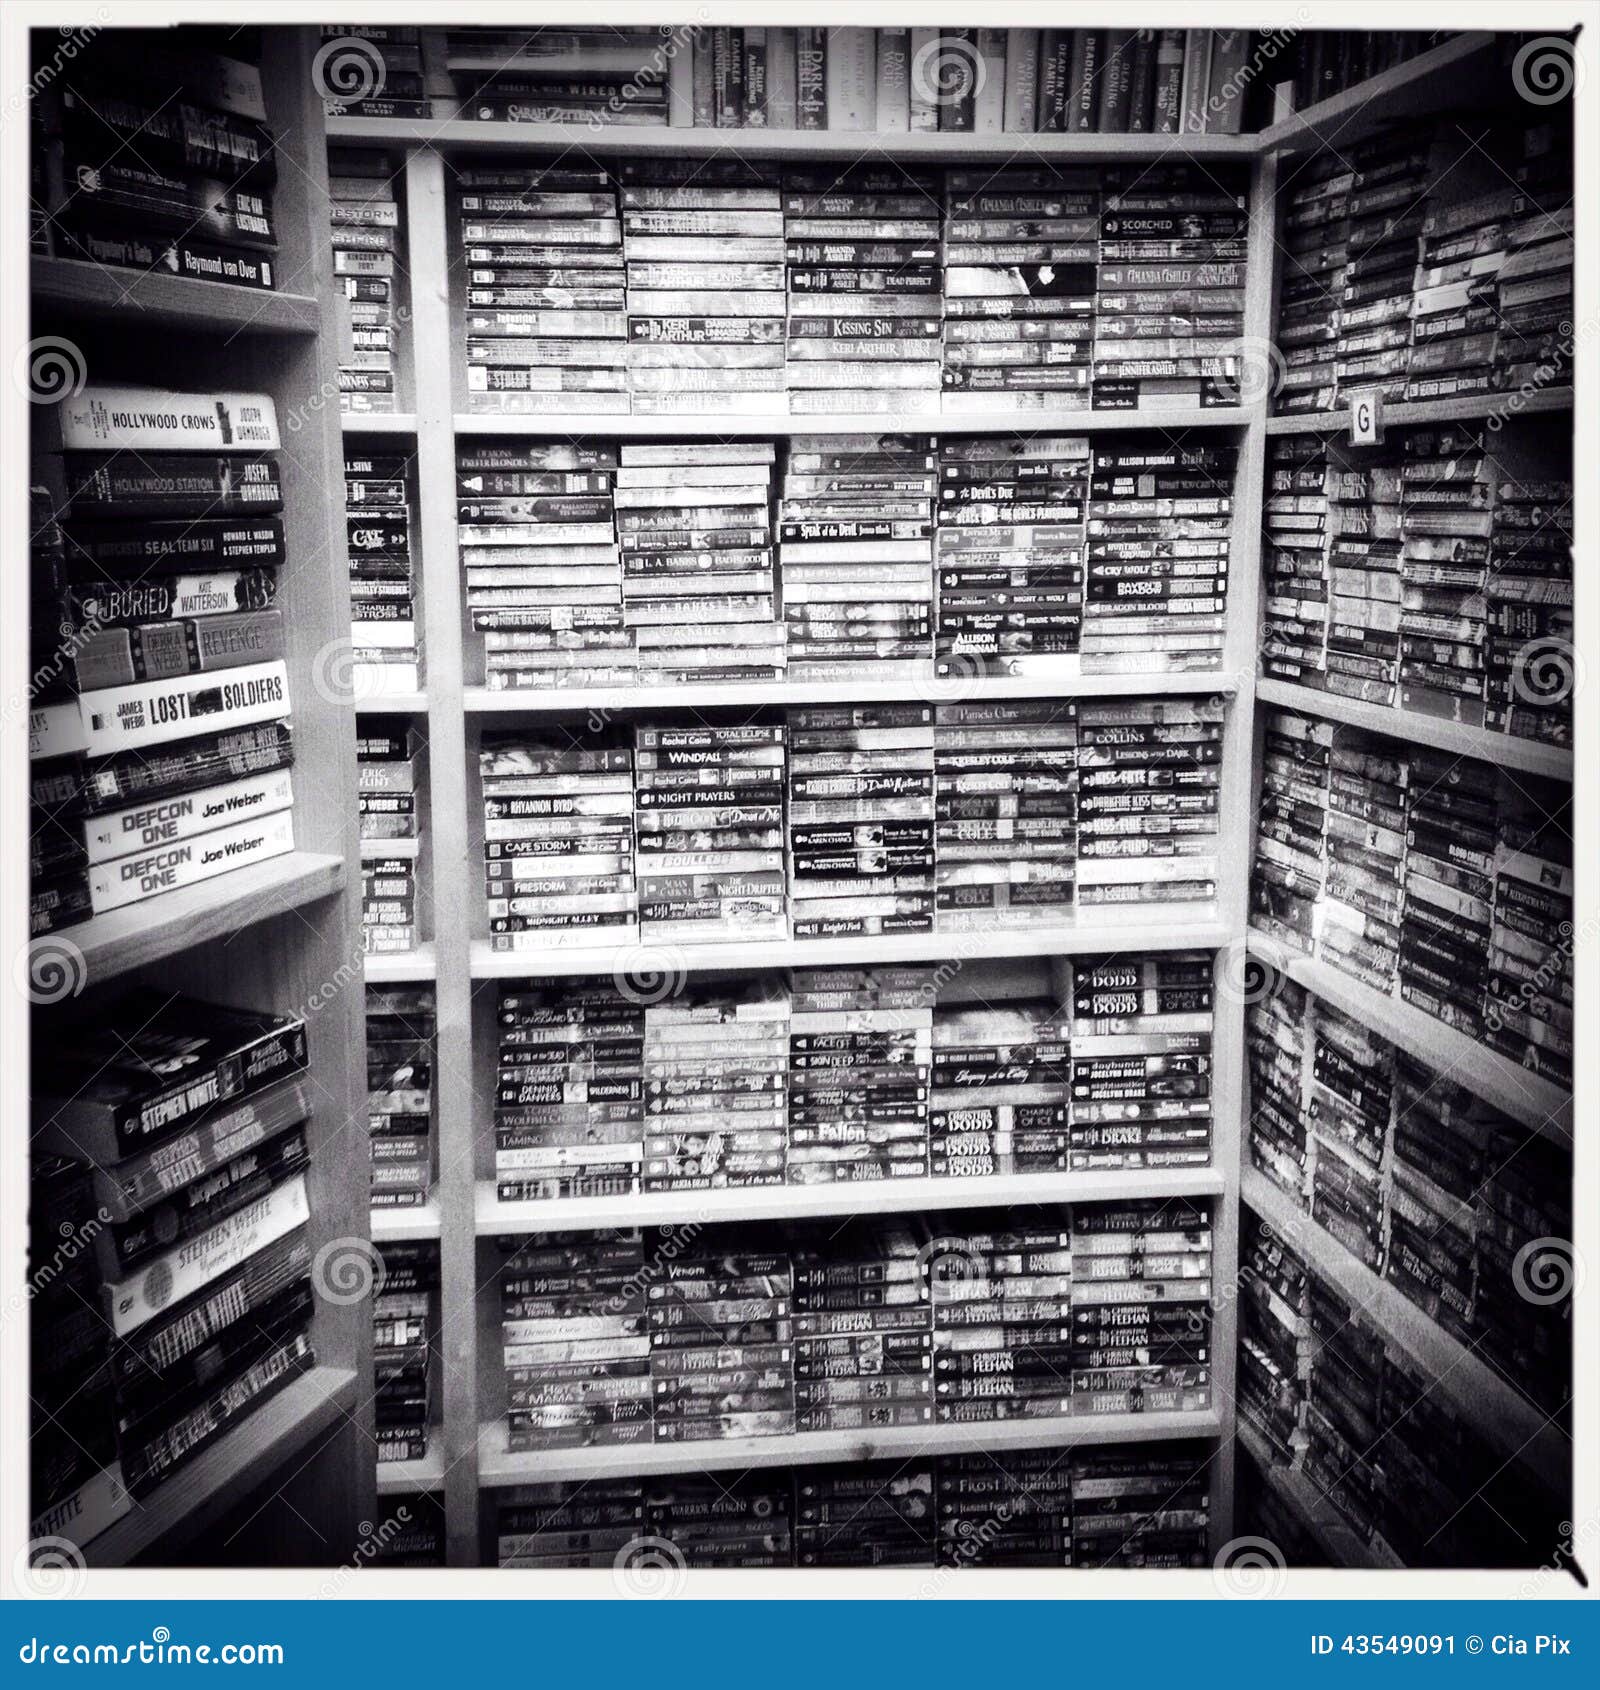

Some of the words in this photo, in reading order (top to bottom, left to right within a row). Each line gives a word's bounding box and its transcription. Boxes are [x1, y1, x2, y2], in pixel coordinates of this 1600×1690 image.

[1045, 57, 1056, 96] FAMILY
[1081, 38, 1096, 110] DEADLOCKED
[569, 86, 616, 96] WIRED
[1122, 219, 1173, 230] SCORCHED
[826, 253, 854, 262] ASHLEY
[185, 250, 222, 274] Raymond
[224, 261, 238, 276] van
[238, 259, 256, 279] Over
[832, 279, 857, 289] ASHLEY
[886, 276, 905, 286] DEAD
[661, 320, 690, 331] KERI
[833, 320, 870, 337] KISSING
[874, 318, 893, 337] SIN
[659, 330, 706, 341] ARTHUR
[832, 343, 855, 355] KERI
[856, 343, 898, 355] ARTHUR
[112, 412, 178, 430] HOLLYWOOD
[182, 415, 215, 430] CROWS
[240, 407, 261, 423] JOSEPH
[1358, 403, 1370, 434] G
[1117, 457, 1144, 466] ALLISON
[1145, 456, 1175, 466] BRENNAN
[244, 464, 269, 481] JOSEPH
[114, 478, 175, 492] HOLLYWOOD
[177, 478, 214, 490] STATION
[997, 486, 1013, 499] DUE
[223, 531, 245, 541] HOWARD
[253, 530, 274, 540] WASDIN
[145, 542, 174, 554] SEAL
[176, 540, 199, 552] TEAM
[201, 538, 215, 551] SIX
[229, 545, 252, 555] STEPHEN
[254, 544, 276, 554] TEMPLIN
[666, 556, 697, 567] BANKS
[1105, 566, 1122, 575] CRY
[1124, 565, 1150, 575] WOLF
[110, 587, 169, 620] BURIED
[181, 592, 229, 612] WATTERSON
[1101, 602, 1137, 613] DRAGON
[1138, 602, 1167, 611] BLOOD
[355, 610, 398, 619] STROSS
[202, 626, 264, 658] REVENGE
[956, 632, 995, 644] ALLISON
[951, 642, 998, 654] BRENNAN
[149, 693, 186, 725] LOST
[223, 676, 282, 711] SOLDIERS
[117, 700, 143, 717] JAMES
[960, 708, 993, 720] Pamela
[994, 706, 1020, 719] Clare
[122, 716, 145, 731] WEBB
[742, 730, 770, 738] ECLIPSE
[1096, 732, 1145, 744] COLLINS
[662, 737, 686, 746] Rachel
[689, 736, 712, 745] Caine
[669, 752, 722, 763] WINDFALL
[1115, 750, 1149, 760] LESSONS
[1166, 748, 1190, 758] DARK
[362, 769, 385, 777] ERIC
[359, 777, 389, 787] FLINT
[658, 792, 692, 802] NIGHT
[695, 791, 735, 801] PRAYERS
[202, 800, 225, 818] Joe
[225, 791, 266, 811] Weber
[368, 800, 399, 811] WEBER
[510, 800, 551, 815] RHYANNON
[553, 799, 572, 813] BYRD
[122, 800, 193, 832] DEFCON
[142, 821, 178, 844] ONE
[200, 846, 223, 865] Joe
[224, 836, 265, 855] Weber
[505, 842, 532, 852] CAPE
[533, 840, 571, 851] STORM
[121, 846, 192, 881] DEFCON
[141, 869, 176, 892] ONE
[514, 882, 566, 893] FIRESTORM
[717, 884, 747, 895] NIGHT
[748, 883, 782, 894] DRIFTER
[527, 916, 568, 926] MIDNIGHT
[571, 915, 600, 924] ALLEY
[1092, 976, 1137, 987] DODD
[1164, 991, 1199, 1000] CHAINS
[1093, 1002, 1137, 1014] DODD
[1182, 1000, 1198, 1009] ICE
[813, 1039, 835, 1048] FACE
[832, 1057, 854, 1067] DEEP
[521, 1085, 558, 1093] DENNIS
[518, 1092, 562, 1103] DANVERS
[141, 1094, 187, 1134] STEPHEN
[187, 1077, 220, 1112] WHITE
[949, 1119, 993, 1130] DODD
[1101, 1134, 1142, 1145] DRAKE
[668, 1264, 705, 1278] Venom
[1111, 1313, 1150, 1325] FEEHAN
[831, 1320, 873, 1332] FEEHAN
[973, 1360, 1014, 1373] FEEHAN
